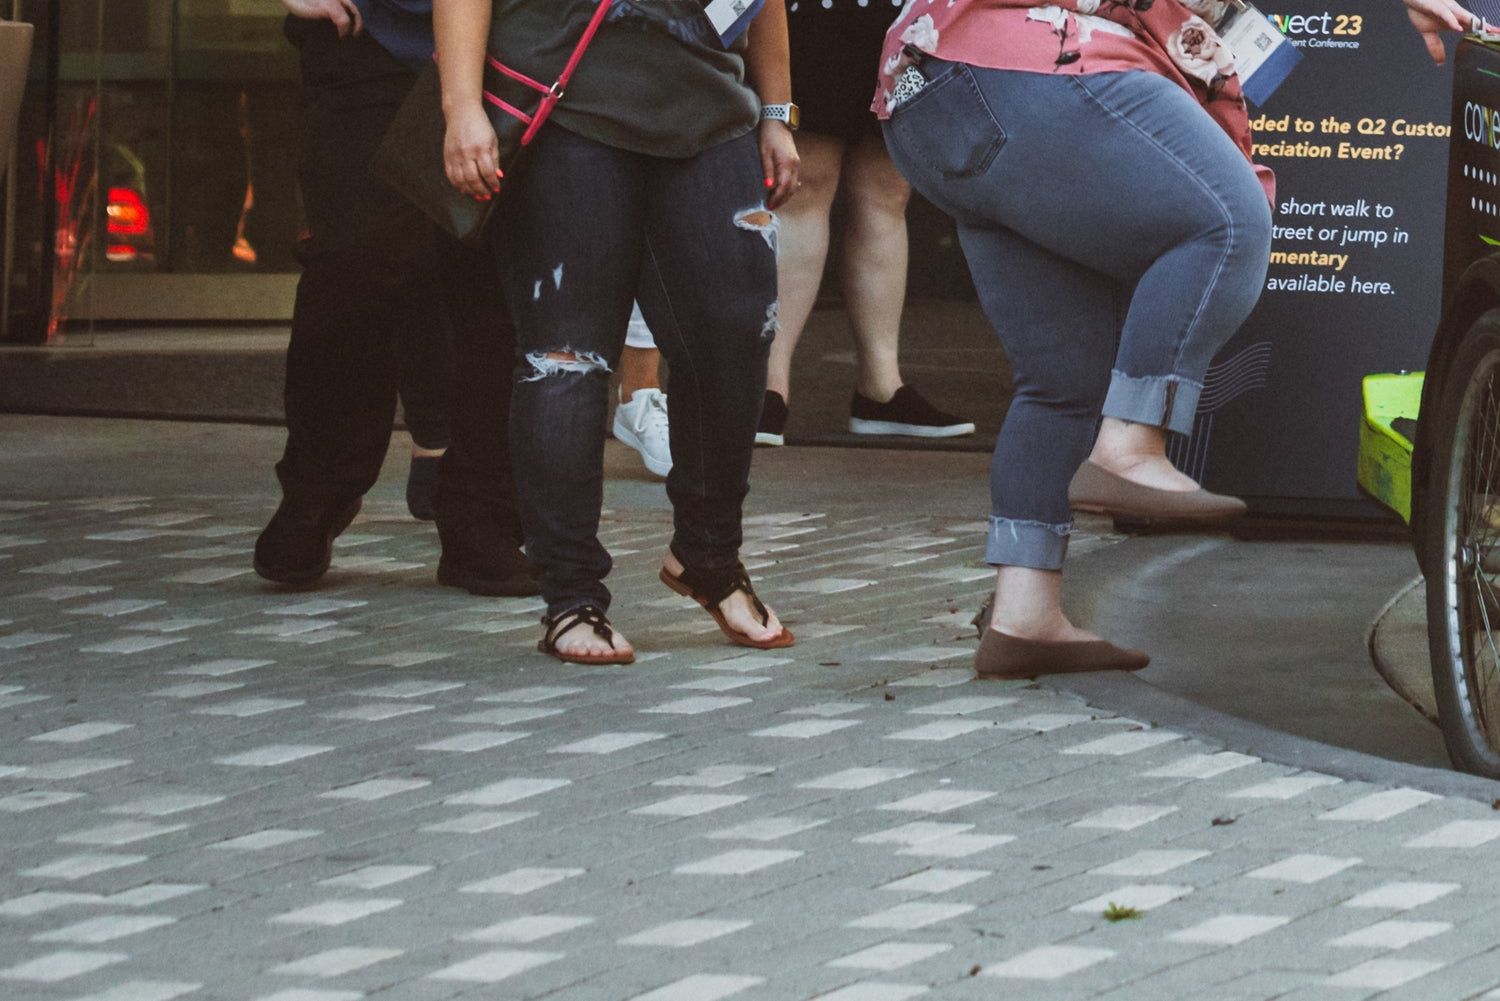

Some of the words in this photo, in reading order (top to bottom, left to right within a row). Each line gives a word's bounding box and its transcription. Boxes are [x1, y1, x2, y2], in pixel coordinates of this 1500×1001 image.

[1333, 14, 1363, 35] 23
[1308, 38, 1360, 49] Conference
[1295, 117, 1314, 133] to
[1320, 116, 1351, 134] the
[1357, 118, 1386, 135] Q2
[1251, 140, 1331, 158] reciation
[1338, 142, 1405, 160] Event?
[1280, 197, 1326, 216] short
[1330, 199, 1370, 218] walk
[1375, 203, 1394, 219] to
[1272, 224, 1314, 240] treet
[1318, 228, 1339, 241] or
[1340, 225, 1388, 248] jump
[1393, 227, 1409, 244] in
[1269, 251, 1348, 271] mentary
[1267, 274, 1346, 293] available
[1351, 276, 1395, 295] here.
